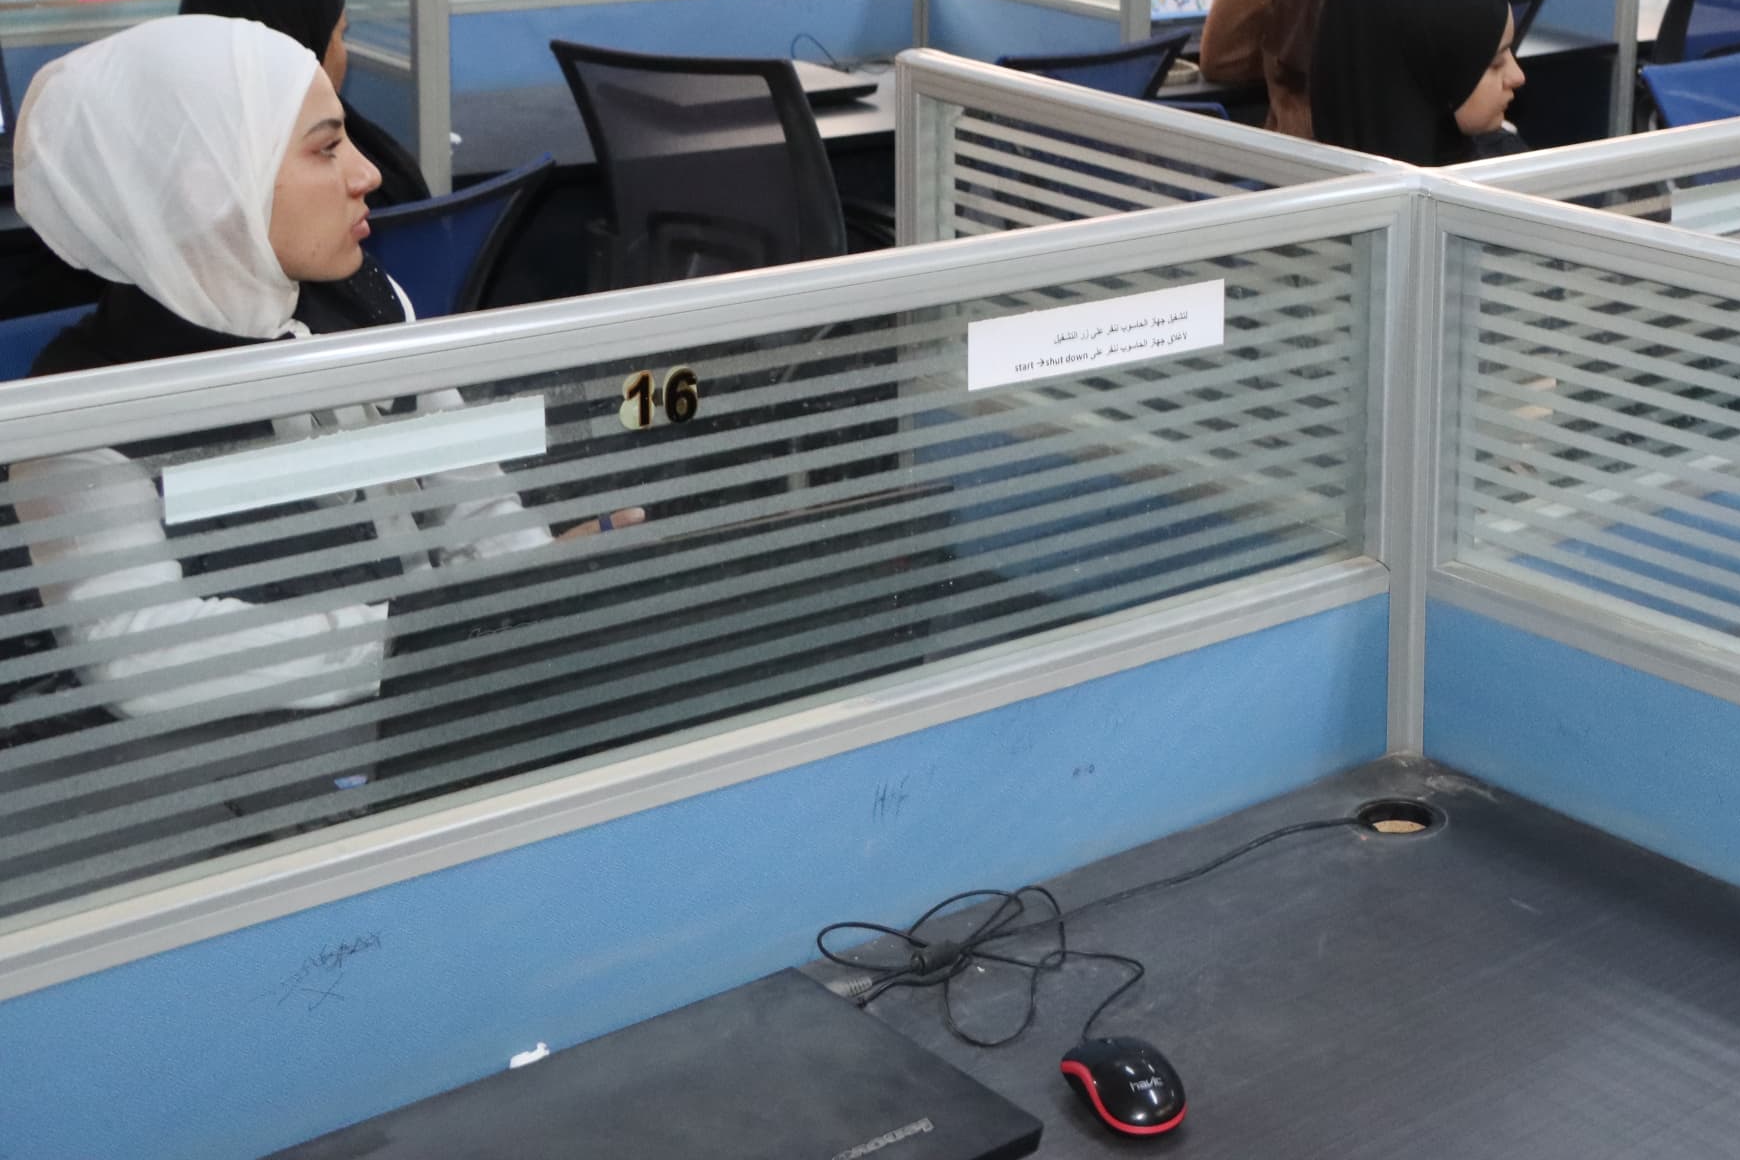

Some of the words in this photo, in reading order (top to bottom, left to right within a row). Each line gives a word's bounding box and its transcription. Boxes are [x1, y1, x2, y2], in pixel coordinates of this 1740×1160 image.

[1120, 318, 1149, 332] الحاسوب
[1014, 360, 1034, 372] start
[1046, 356, 1063, 367] shut
[1065, 352, 1089, 363] down
[624, 365, 698, 428] 16
